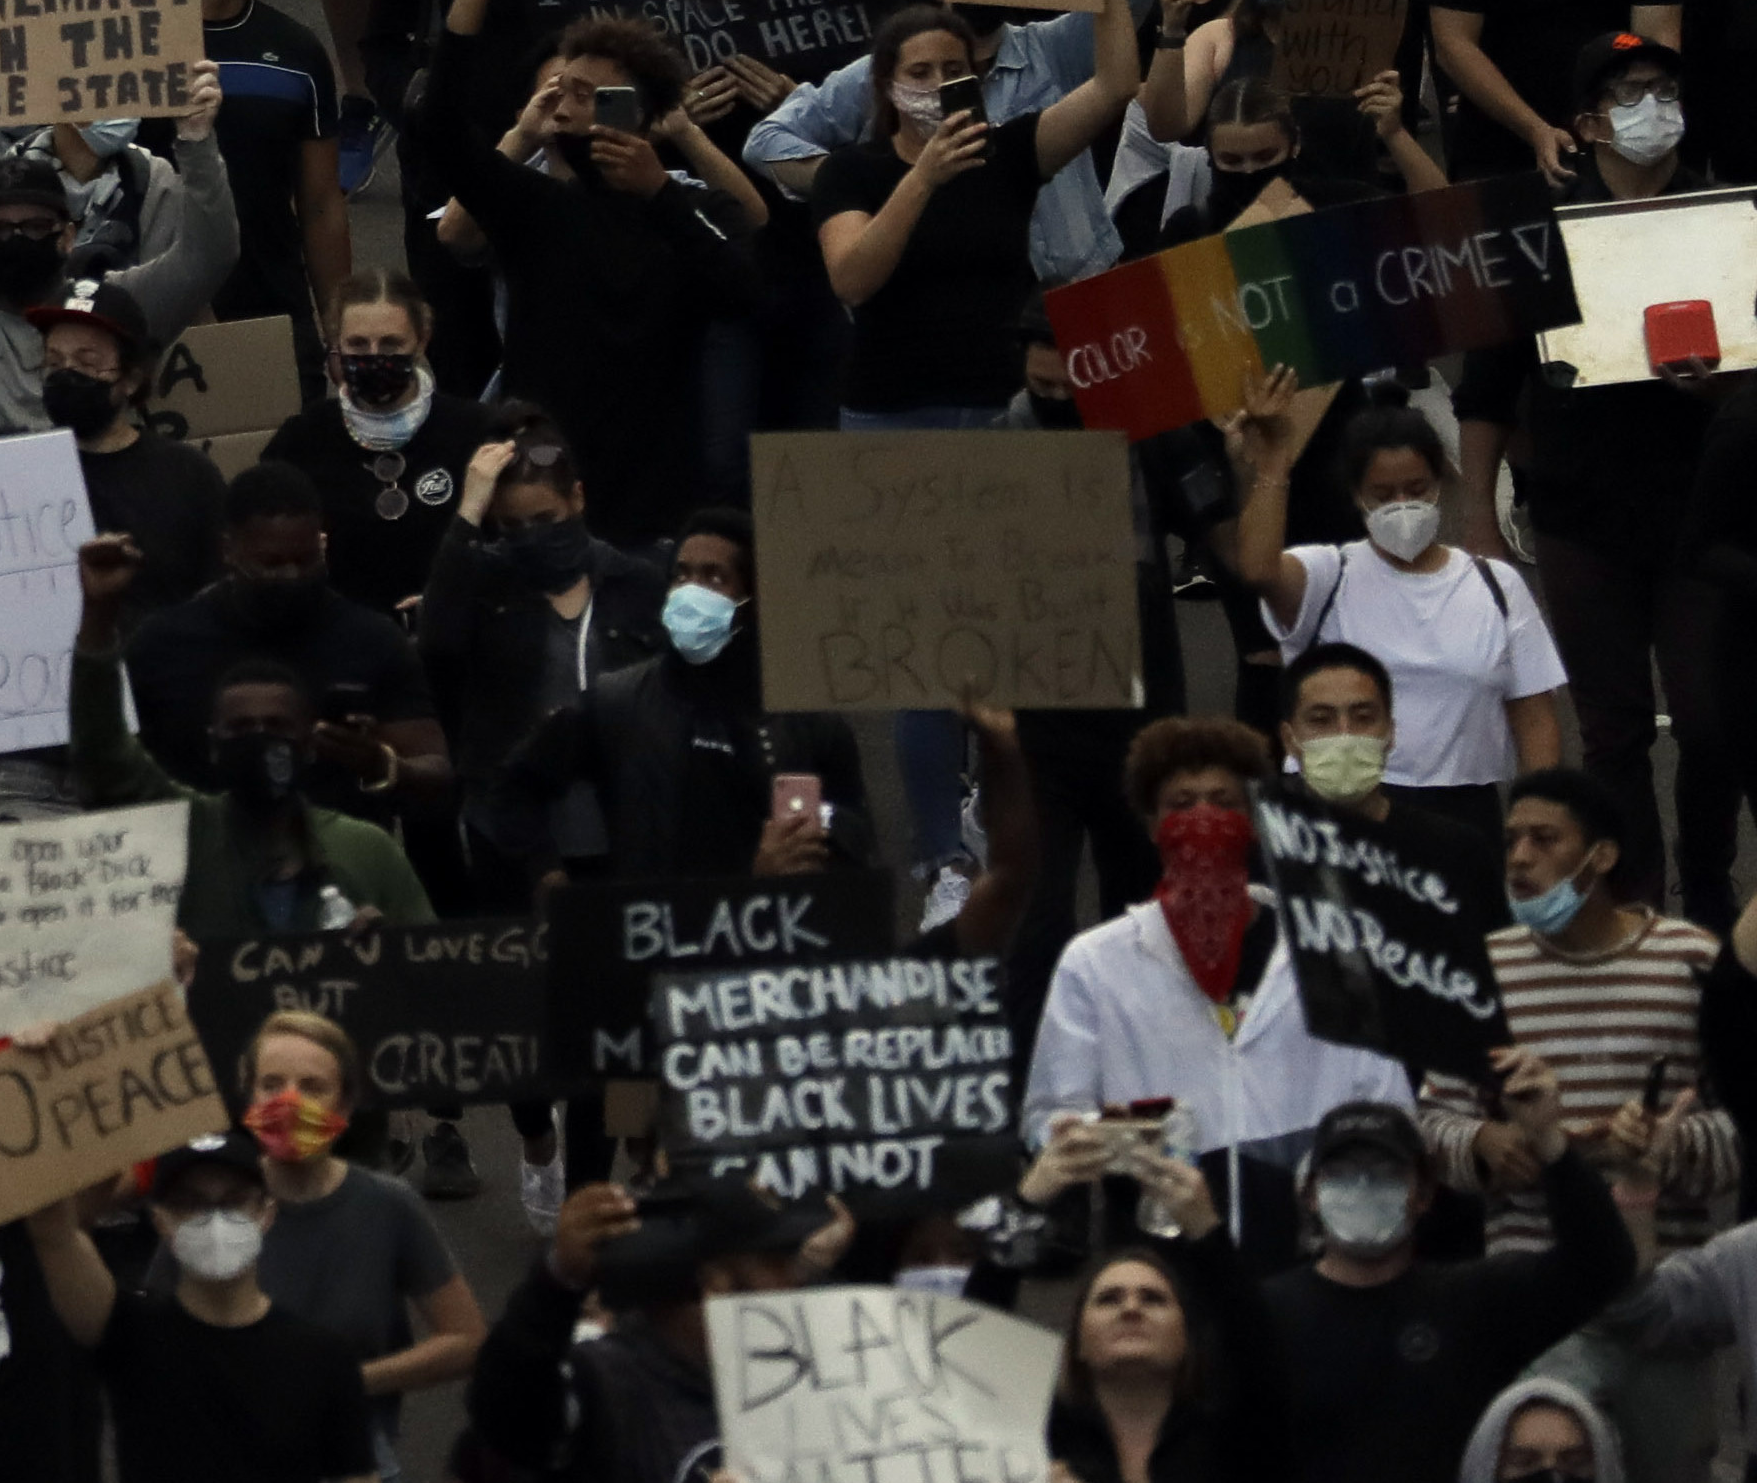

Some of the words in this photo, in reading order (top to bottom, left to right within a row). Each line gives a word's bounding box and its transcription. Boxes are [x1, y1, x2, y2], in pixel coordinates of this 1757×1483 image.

[61, 9, 160, 69] THE
[759, 10, 875, 58] HERE!
[1067, 326, 1150, 390] COLOR
[622, 894, 830, 962] BLACK
[663, 959, 1001, 1038] MERCHANDISE
[46, 1039, 220, 1160] PEACE
[687, 1078, 849, 1140] BLACK
[868, 1076, 1010, 1135] LIVES
[733, 1296, 1004, 1414] BLACK
